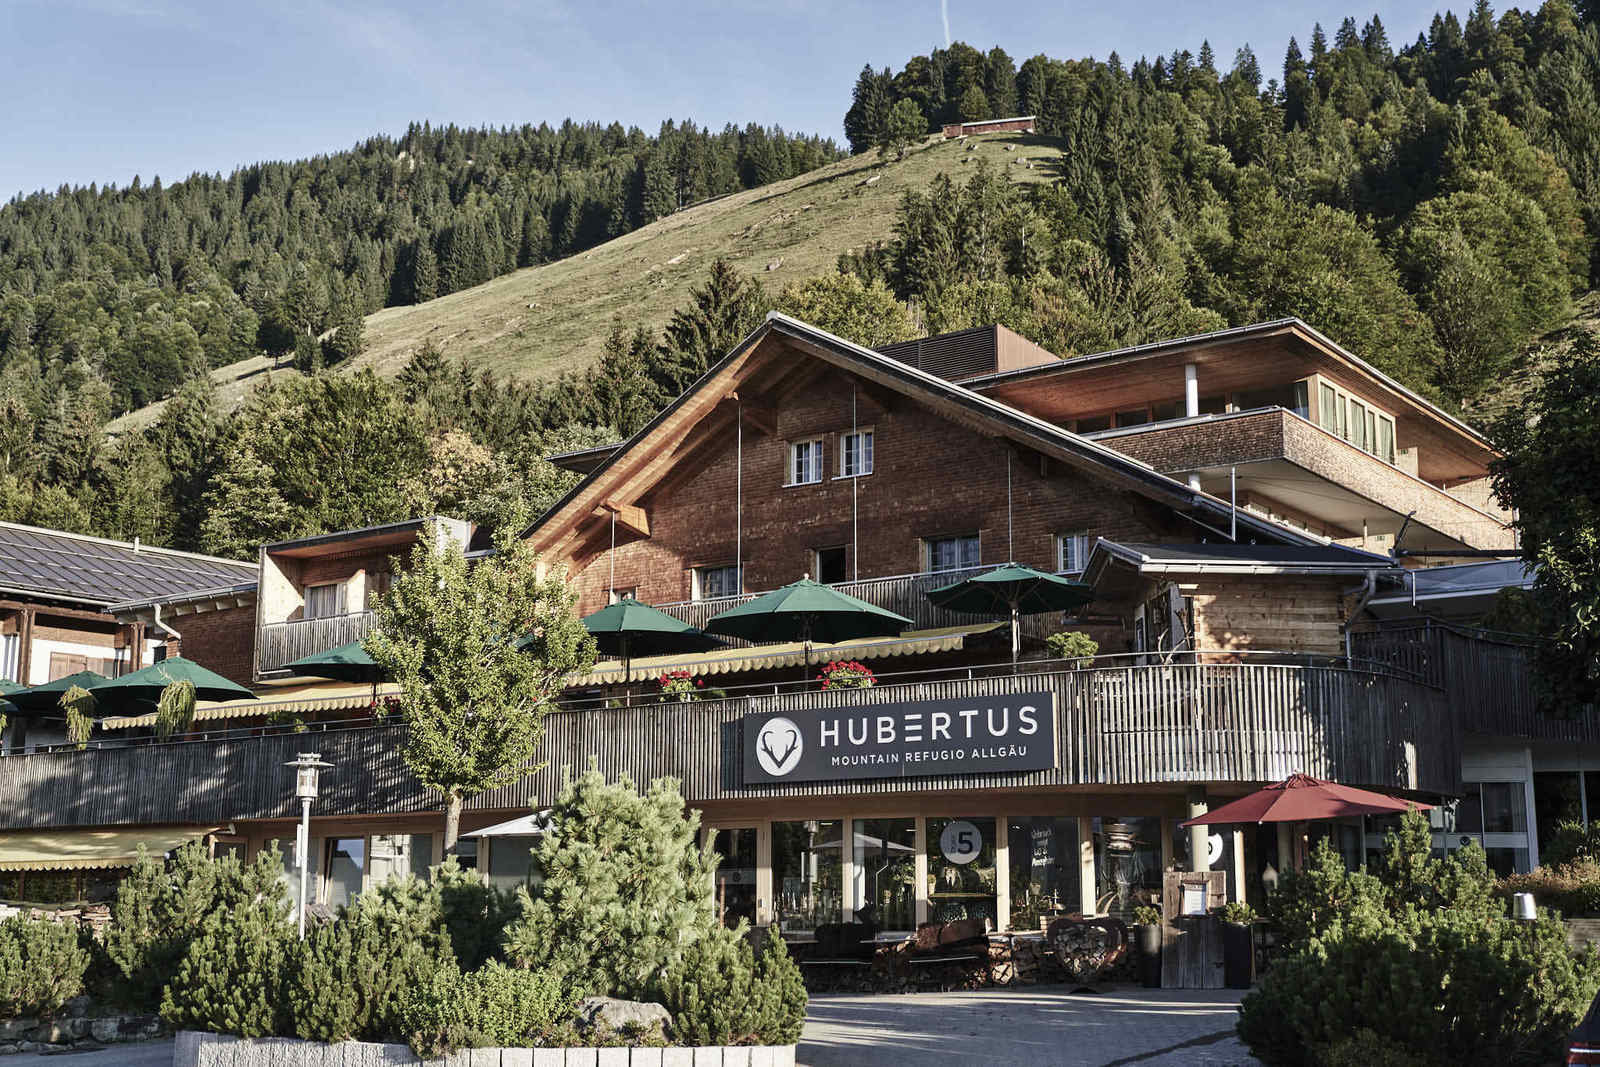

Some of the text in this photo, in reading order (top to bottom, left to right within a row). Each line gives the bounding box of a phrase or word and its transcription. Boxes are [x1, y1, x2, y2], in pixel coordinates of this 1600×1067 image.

[820, 705, 1038, 747] HUBERTUS
[831, 744, 1027, 766] MOUNTAIN REFUGIO ALLGÄU
[957, 831, 973, 854] 5
